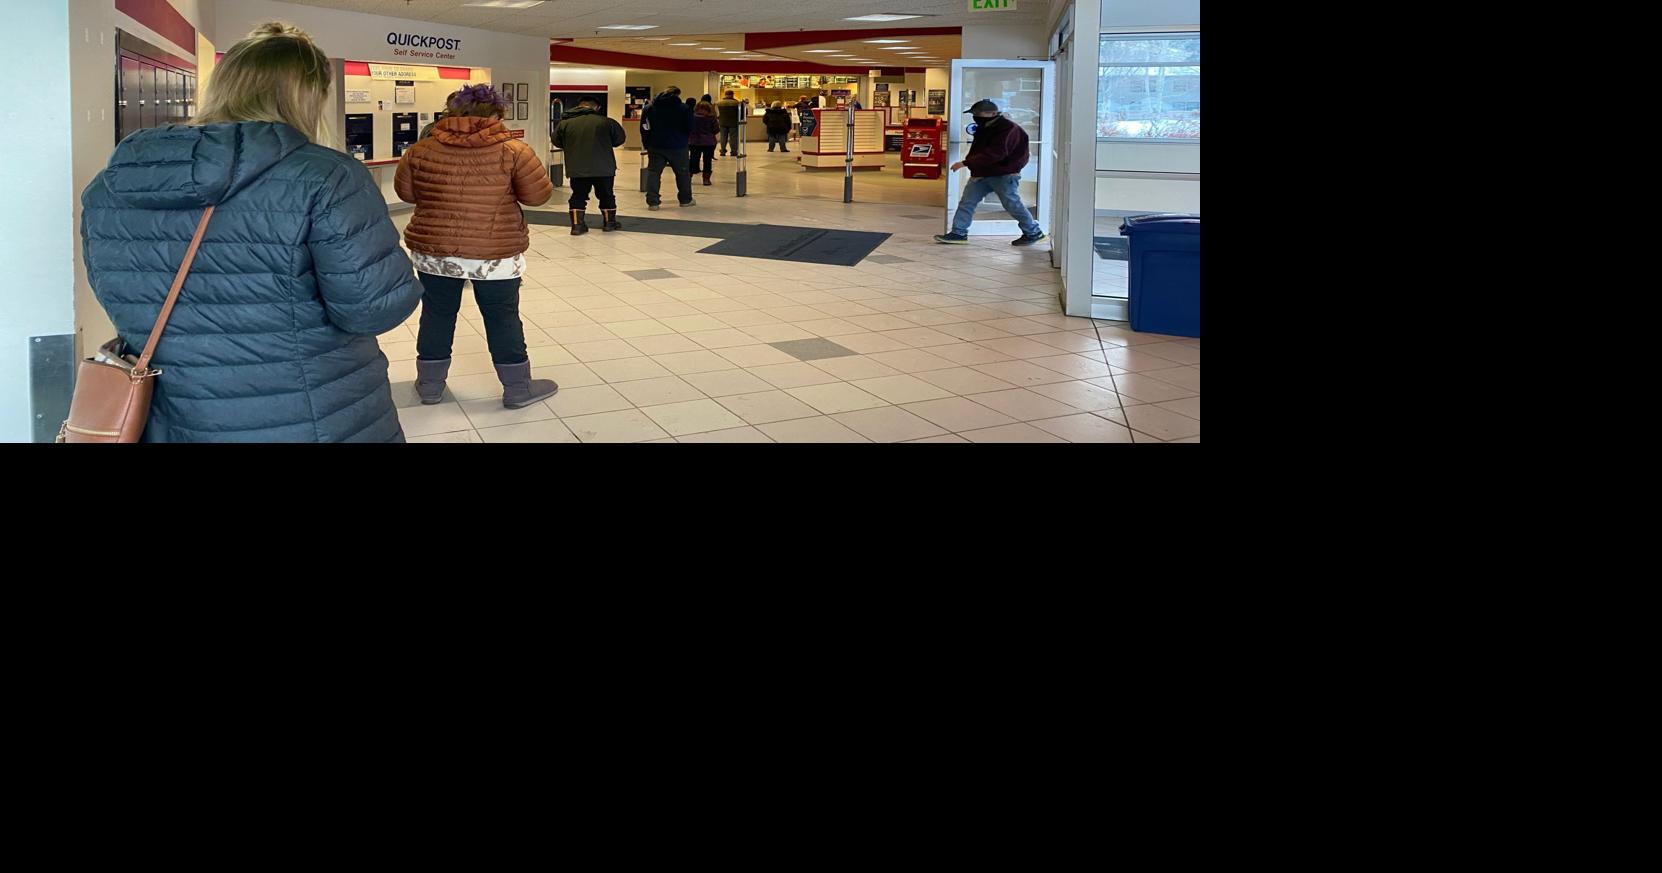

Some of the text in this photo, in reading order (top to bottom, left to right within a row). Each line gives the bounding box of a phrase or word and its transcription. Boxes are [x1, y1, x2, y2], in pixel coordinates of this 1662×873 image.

[386, 32, 461, 51] QUICKPOST
[394, 48, 456, 60] Self Service Center
